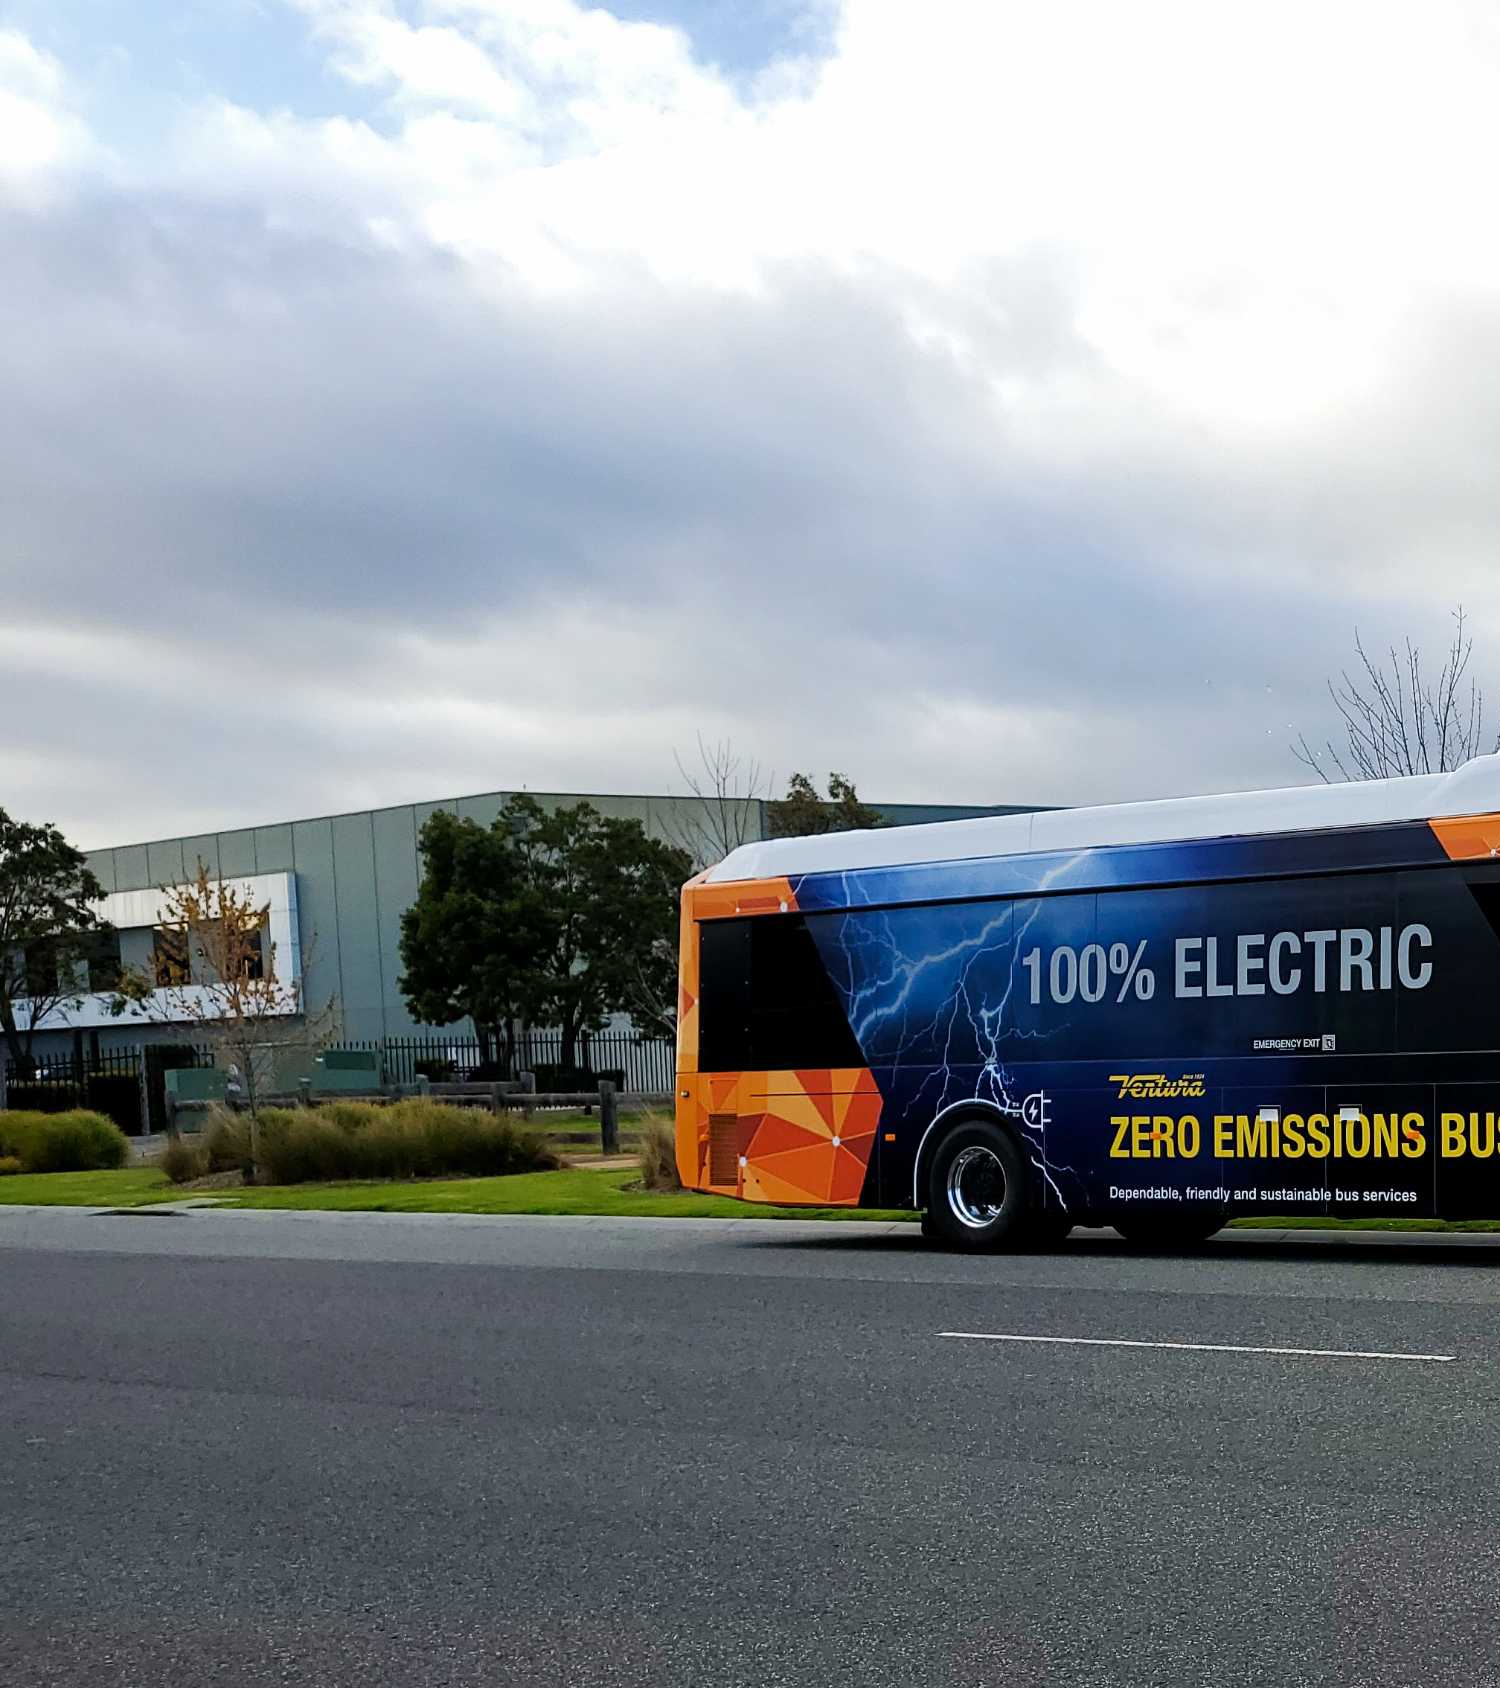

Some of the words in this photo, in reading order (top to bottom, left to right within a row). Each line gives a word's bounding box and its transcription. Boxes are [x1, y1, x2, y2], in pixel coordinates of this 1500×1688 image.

[1022, 939, 1155, 1004] 100%
[1175, 923, 1433, 998] ELECTRIC
[1253, 1039, 1302, 1049] EMERGENCY
[1303, 1038, 1321, 1048] EXIT
[1108, 1074, 1206, 1099] Ventura
[1109, 1115, 1201, 1158] ZERO
[1213, 1113, 1426, 1158] EMISSIONS
[1109, 1186, 1183, 1201] Dependable,
[1185, 1186, 1231, 1203] friendly
[1233, 1187, 1257, 1201] and
[1260, 1187, 1332, 1201] sustainable
[1335, 1187, 1360, 1202] bus
[1362, 1188, 1418, 1202] services
